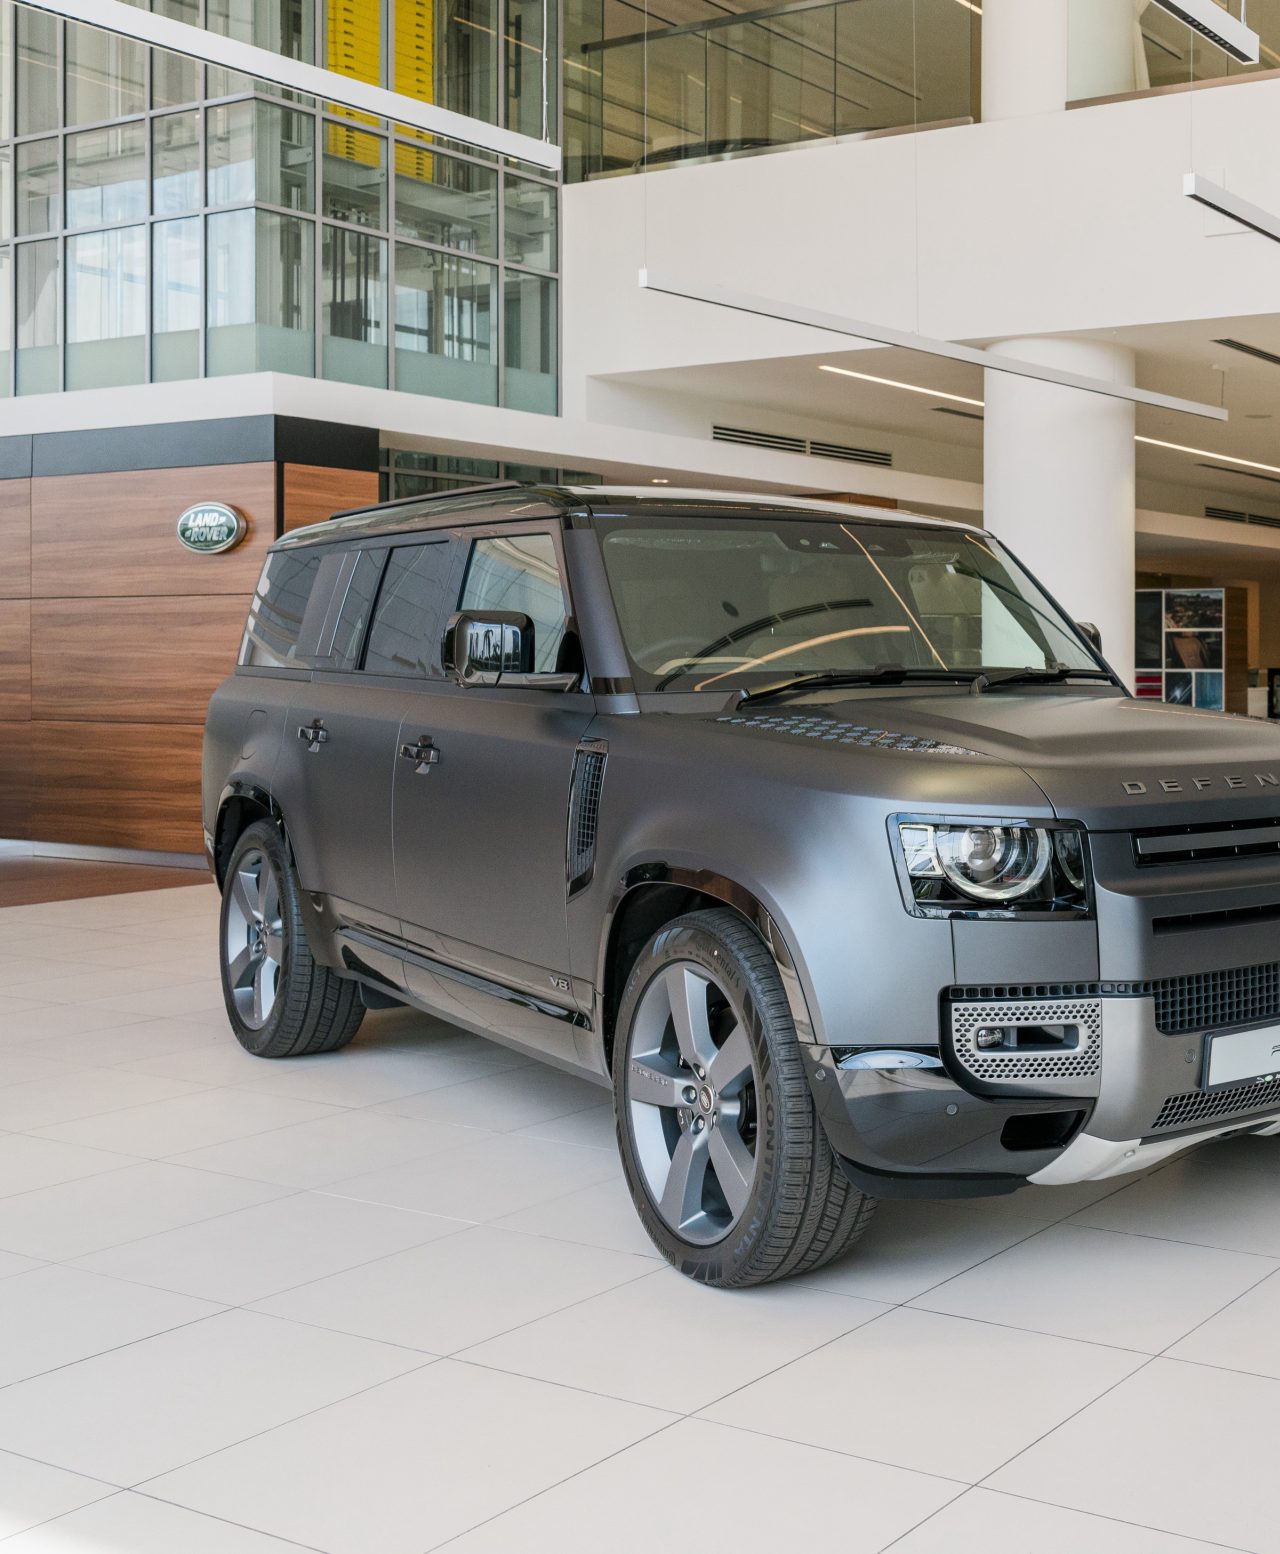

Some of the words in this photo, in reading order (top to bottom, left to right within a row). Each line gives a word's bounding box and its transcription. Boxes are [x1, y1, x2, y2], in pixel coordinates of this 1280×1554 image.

[188, 512, 220, 527] LAND
[190, 526, 228, 542] ROVER
[549, 975, 570, 991] V8
